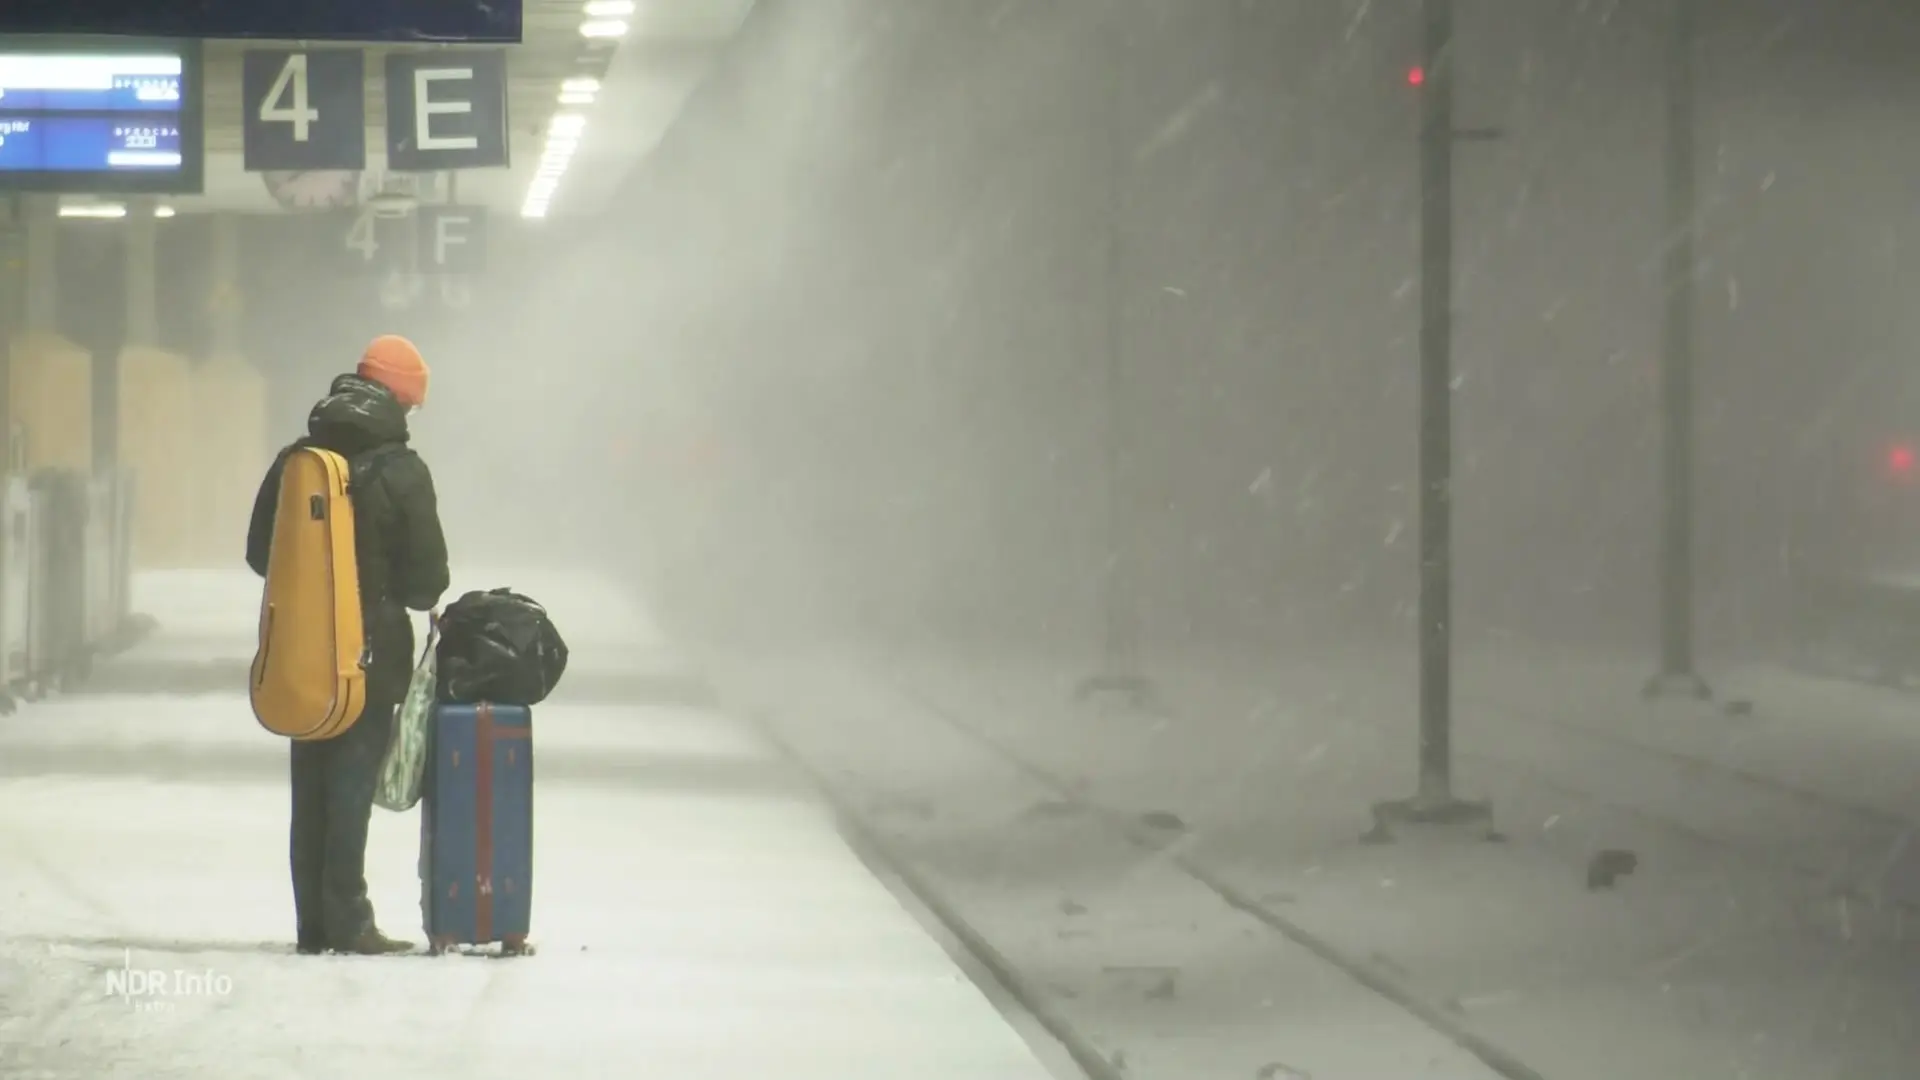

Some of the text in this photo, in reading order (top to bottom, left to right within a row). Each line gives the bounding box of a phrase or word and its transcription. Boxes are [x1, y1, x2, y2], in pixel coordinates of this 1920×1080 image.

[259, 53, 320, 142] 4
[414, 67, 478, 151] E
[346, 208, 380, 261] 4
[434, 215, 471, 265] F
